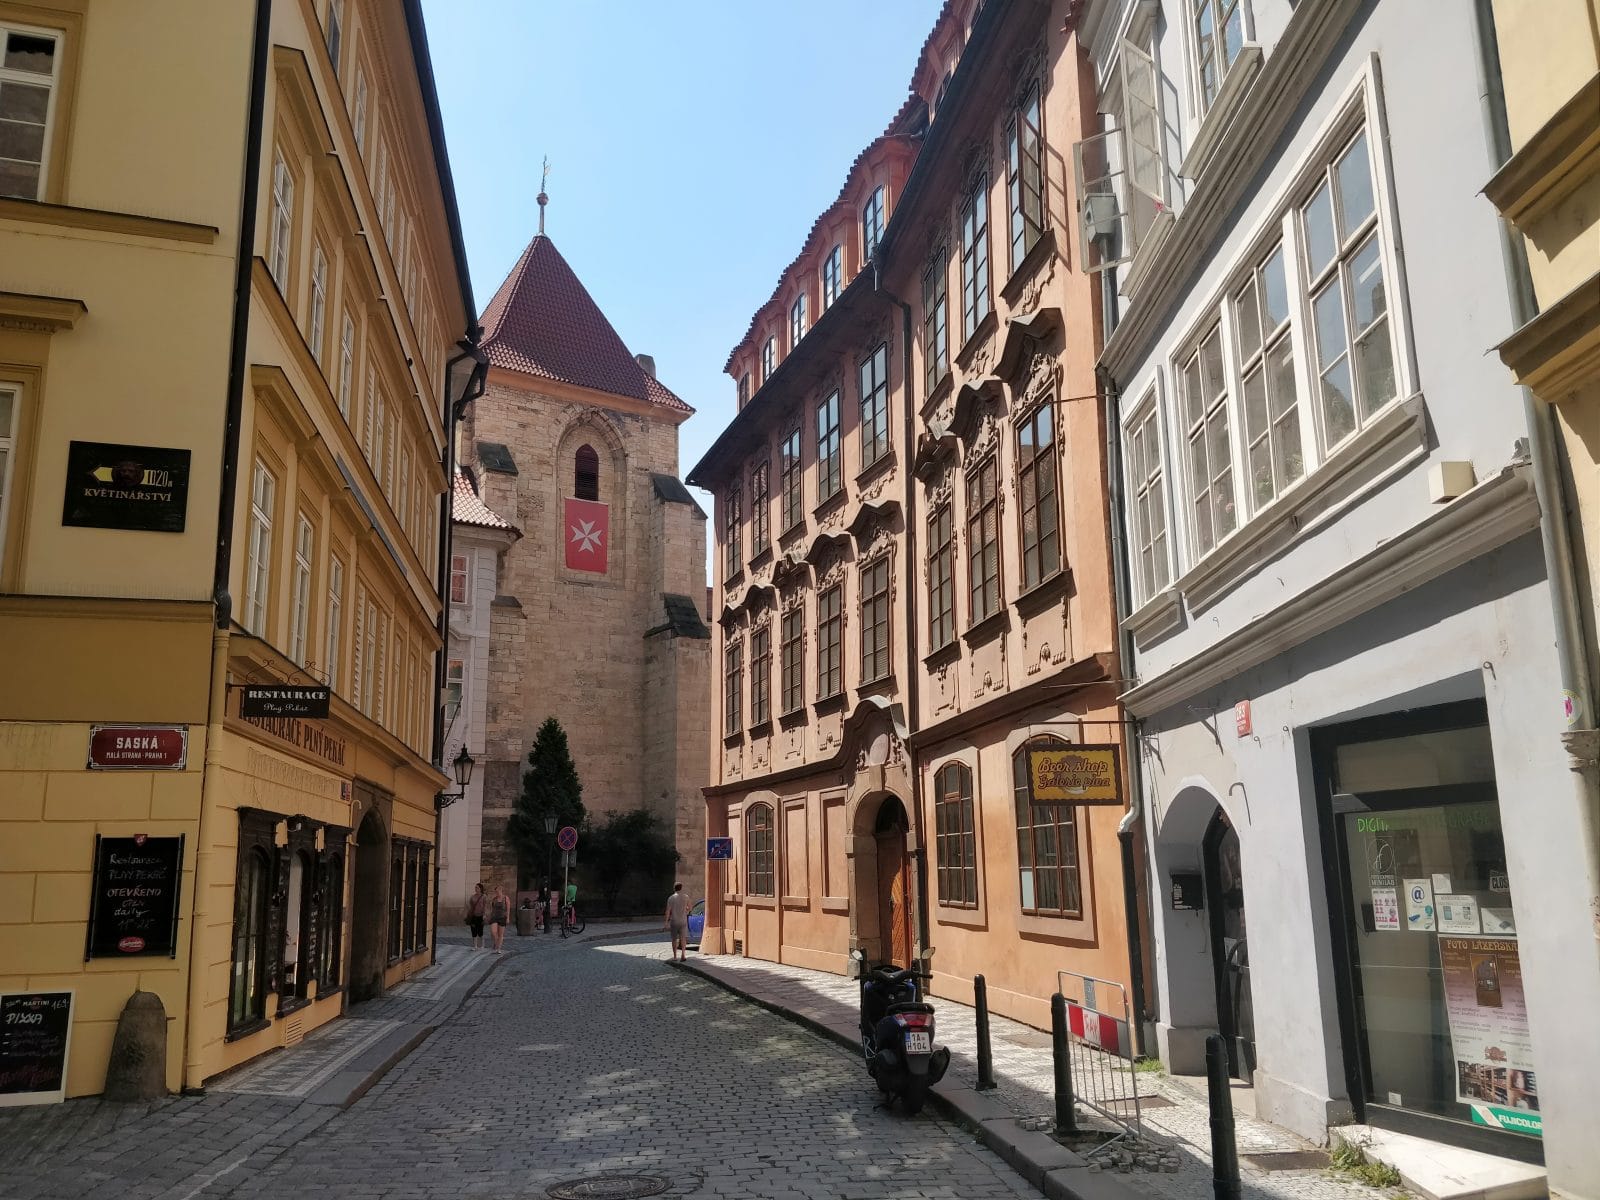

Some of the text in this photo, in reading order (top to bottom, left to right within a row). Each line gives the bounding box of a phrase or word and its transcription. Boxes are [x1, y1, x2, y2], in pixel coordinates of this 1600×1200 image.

[248, 690, 328, 700] RESTAURACE
[116, 736, 158, 749] SASKÁ
[106, 751, 120, 759] MALÁ
[121, 751, 142, 759] STRANA
[144, 751, 163, 759] PRAHA
[1038, 757, 1108, 776] Beer shop
[1447, 940, 1468, 949] FOTO
